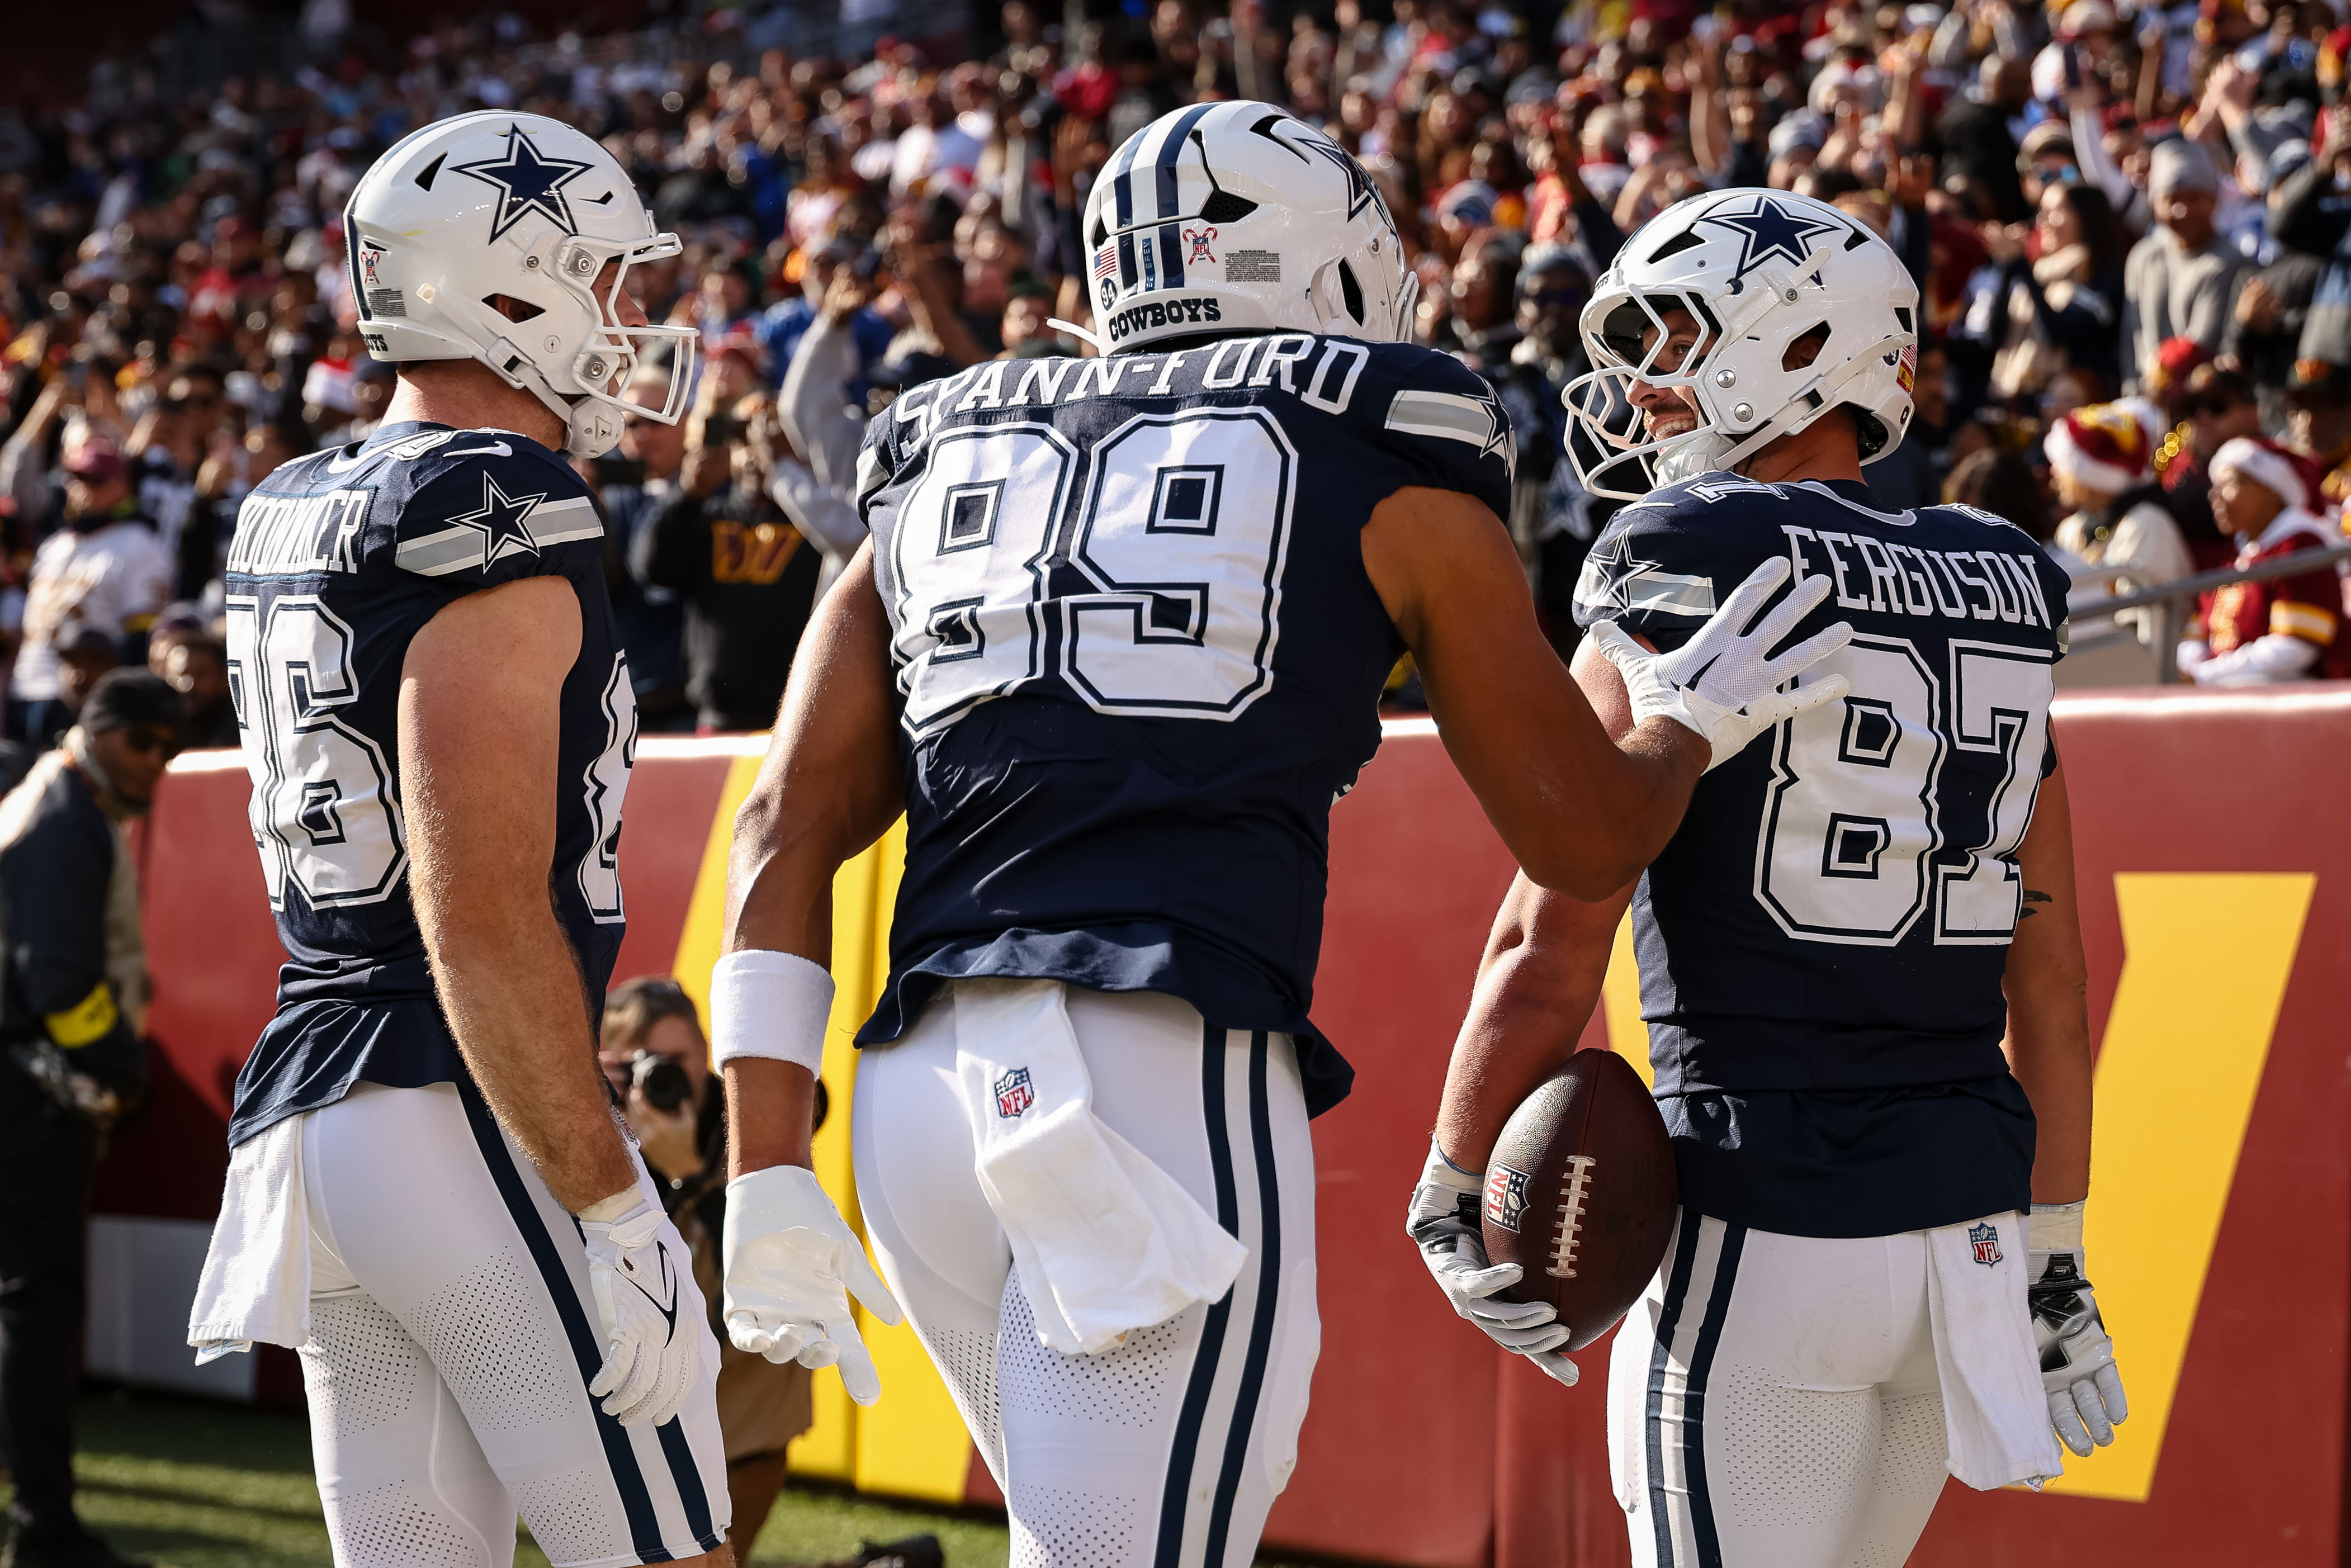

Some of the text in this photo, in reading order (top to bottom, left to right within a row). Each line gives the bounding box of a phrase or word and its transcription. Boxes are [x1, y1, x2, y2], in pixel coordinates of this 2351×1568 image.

[1195, 244, 1208, 253] NFL
[1101, 282, 1116, 307] 94
[1109, 298, 1221, 342] COWBOYS
[895, 334, 1370, 459] SPANN-FORD
[890, 406, 1298, 743] 89
[1780, 525, 2051, 630] FERGUSON
[1753, 632, 2053, 946] 87
[999, 1086, 1032, 1115] NFL
[1488, 1169, 1508, 1215] NFL
[1974, 1242, 2001, 1262] NFL
